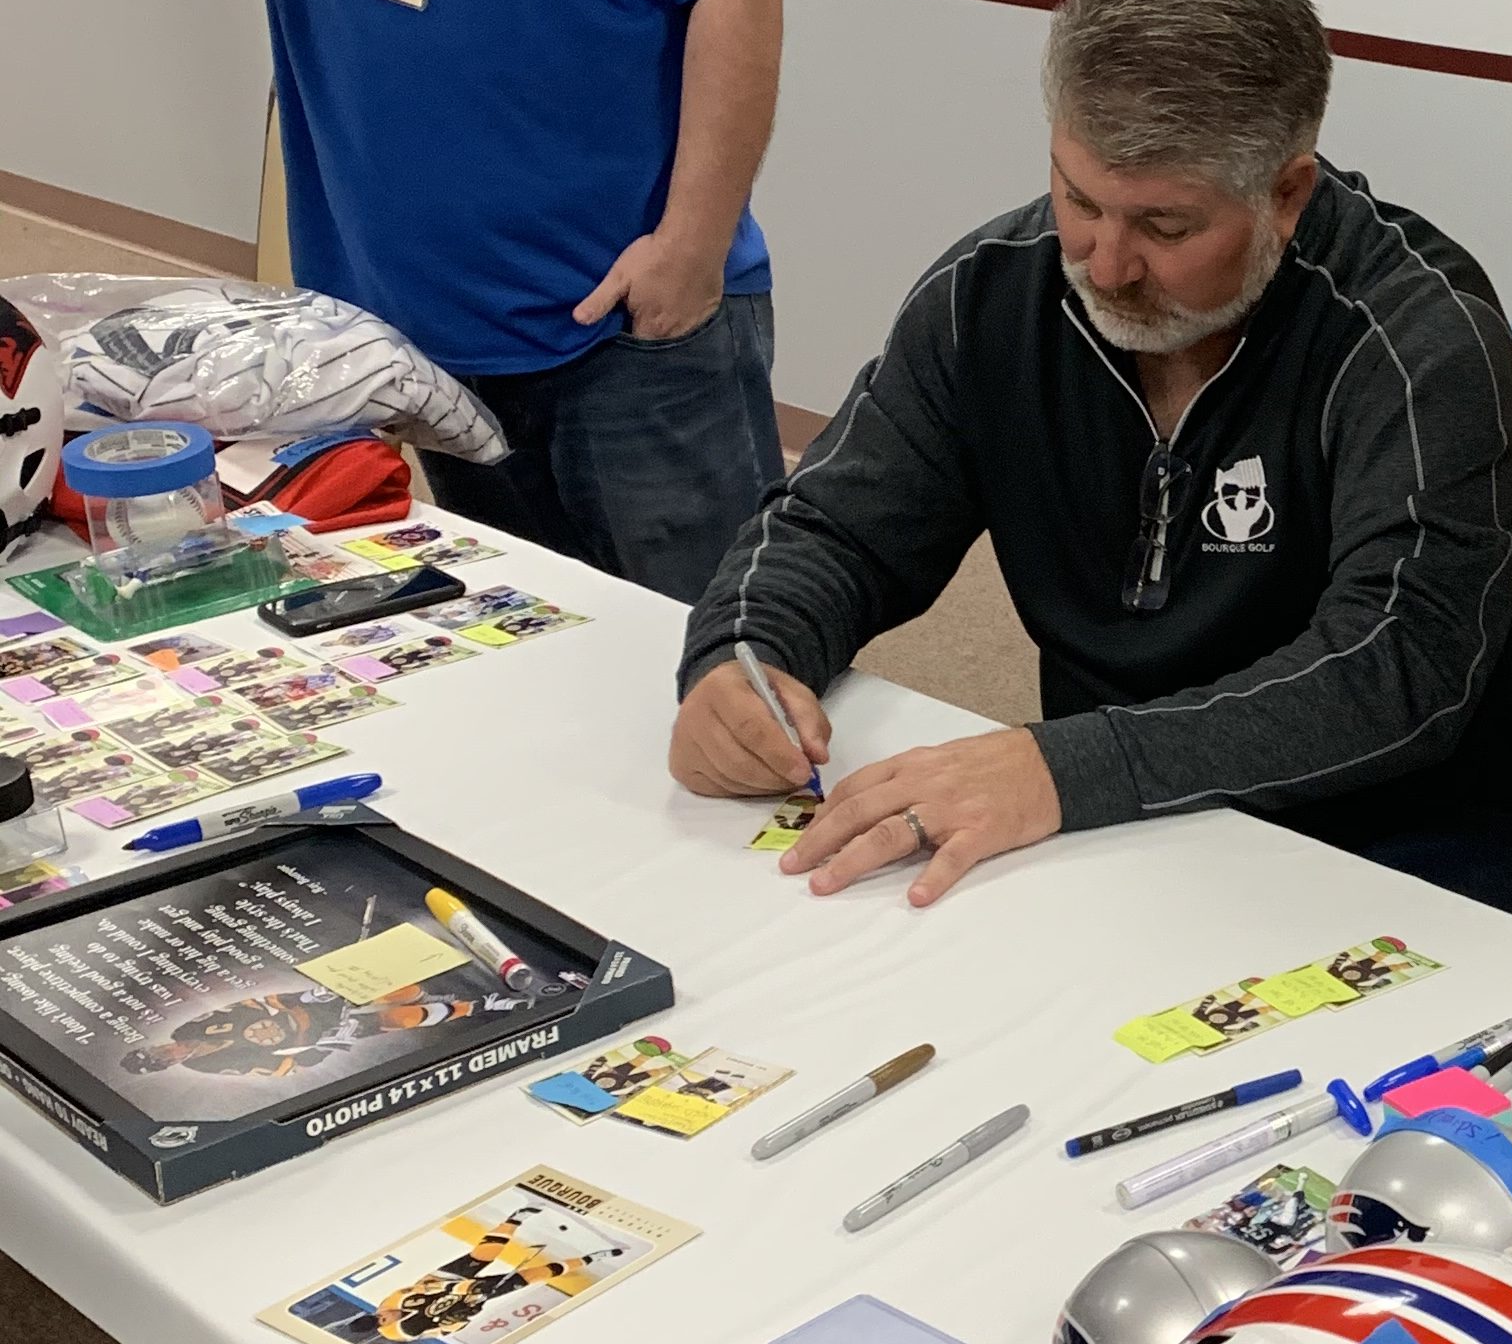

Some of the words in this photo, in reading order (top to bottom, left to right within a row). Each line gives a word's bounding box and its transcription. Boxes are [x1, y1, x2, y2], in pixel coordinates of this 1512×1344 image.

[1201, 543, 1247, 554] BOURQUE
[1248, 543, 1276, 554] GOLF
[157, 904, 190, 919] get
[234, 898, 269, 919] style
[273, 896, 316, 922] always
[137, 918, 172, 940] make
[172, 916, 205, 933] and
[261, 915, 287, 930] the
[303, 918, 323, 927] I
[87, 941, 108, 954] do
[106, 928, 148, 953] could
[164, 936, 185, 948] or
[199, 928, 234, 953] play
[234, 924, 300, 965] something
[279, 926, 321, 955] That's
[102, 951, 121, 966] to
[136, 947, 152, 958] I
[177, 945, 203, 962] hit
[215, 944, 263, 965] good
[113, 958, 154, 987] trying
[148, 951, 211, 993] everything
[195, 955, 222, 974] big
[216, 968, 231, 977] a
[251, 962, 265, 971] a
[79, 969, 125, 992] good
[38, 969, 105, 1014] competitive
[112, 988, 128, 998] a
[148, 982, 174, 1001] was
[33, 997, 61, 1017] like
[119, 994, 146, 1012] not
[164, 997, 185, 1007] I
[51, 1011, 88, 1035] don't
[98, 1010, 114, 1020] a
[136, 1007, 167, 1026] it's
[105, 1014, 145, 1045] Being
[468, 1025, 560, 1073] FRAMED
[305, 1093, 383, 1138] PHOTO
[528, 1174, 604, 1209] BOURQUE
